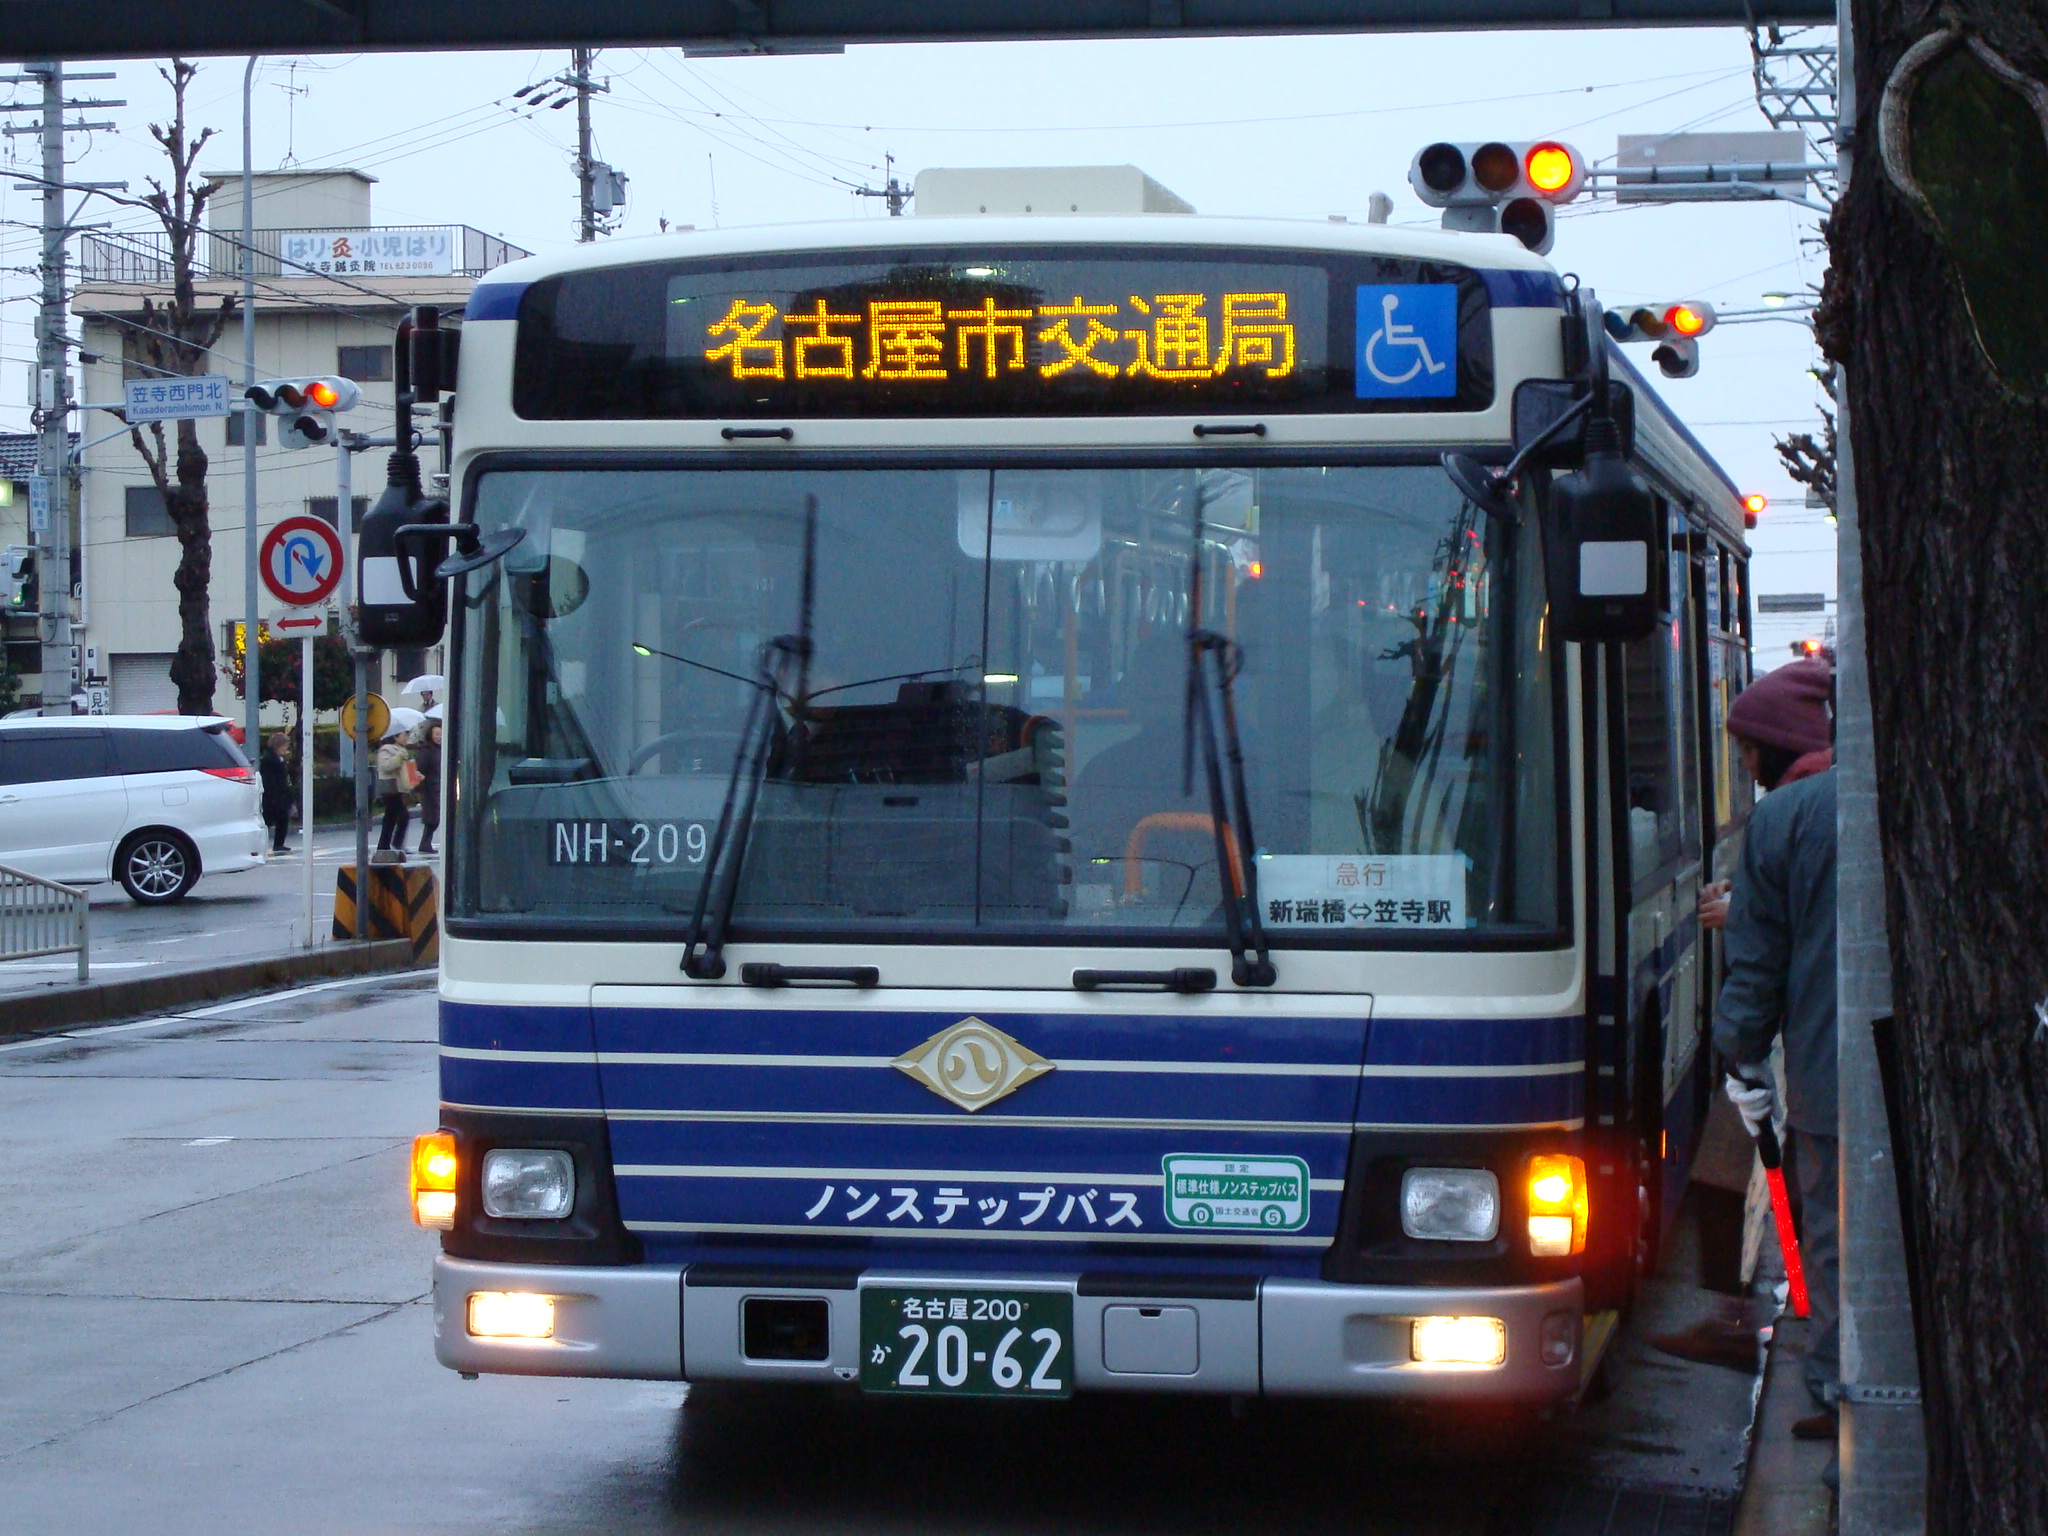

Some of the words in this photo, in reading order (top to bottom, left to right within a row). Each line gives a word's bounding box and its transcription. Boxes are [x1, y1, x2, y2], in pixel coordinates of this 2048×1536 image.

[705, 292, 1296, 380] 名古屋市交通局
[132, 383, 222, 403] 笠寺西門北
[215, 402, 223, 410] N.
[556, 822, 706, 863] NH-209
[1336, 863, 1387, 886] 急行
[1270, 899, 1346, 923] 新瑞橋
[1373, 899, 1452, 924] 笠寺駅
[1176, 1178, 1298, 1197] 標準仕様ノンステップバス
[804, 1184, 1144, 1229] ノンステップバス
[1215, 1206, 1260, 1217] 国土交通省
[902, 1298, 968, 1322] 名古屋
[973, 1299, 1022, 1322] 200
[871, 1343, 893, 1366] か
[898, 1324, 1063, 1392] 20-62
